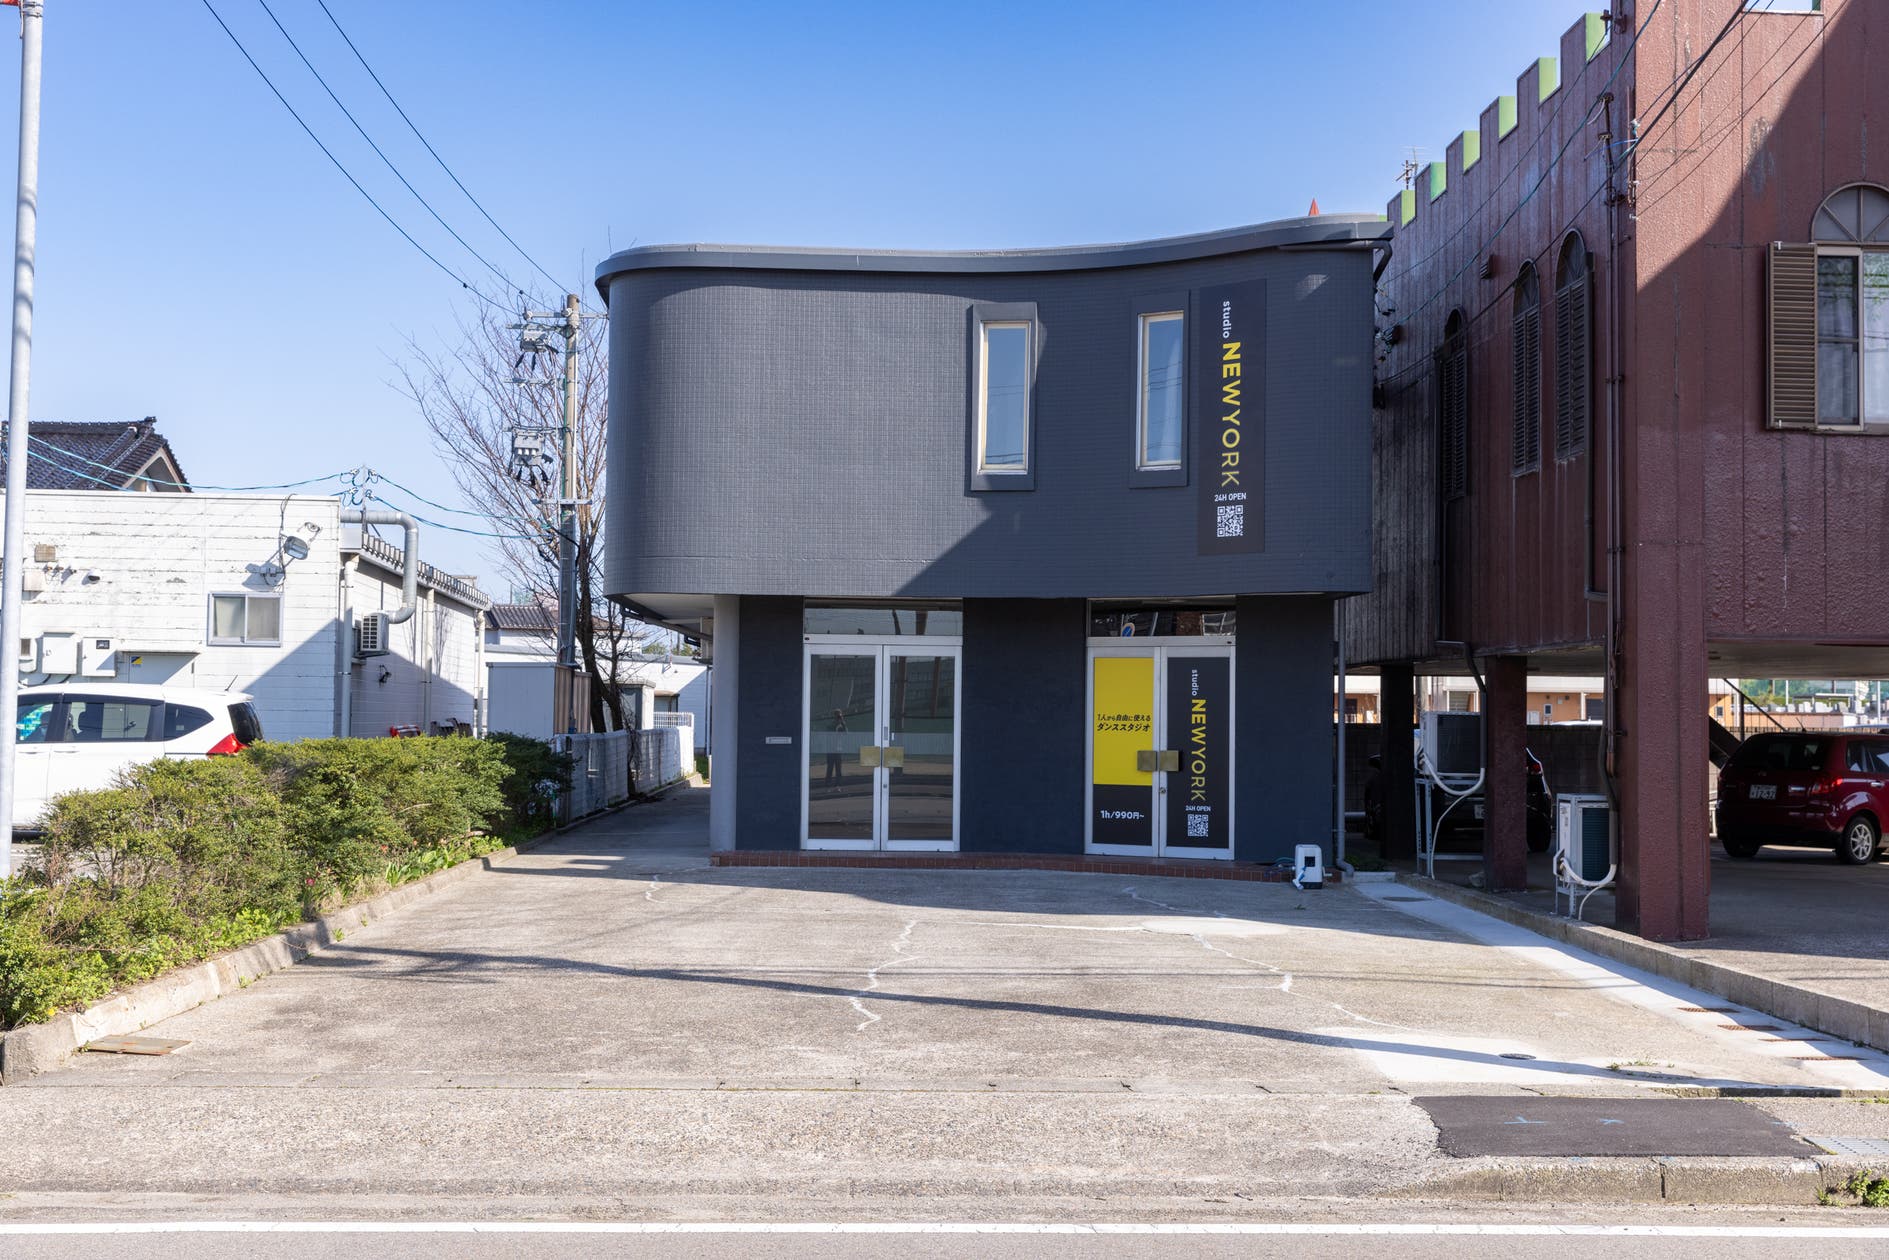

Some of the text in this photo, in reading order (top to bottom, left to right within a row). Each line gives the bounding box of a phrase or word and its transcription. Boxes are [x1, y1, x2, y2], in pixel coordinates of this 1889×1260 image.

[1221, 300, 1241, 486] studio NEWYORK
[1214, 492, 1247, 502] 24H OPEN
[1097, 713, 1151, 722] 1人から自由に使える
[1097, 722, 1151, 732] ダンススタジオ
[1191, 699, 1206, 800] NEWYORK
